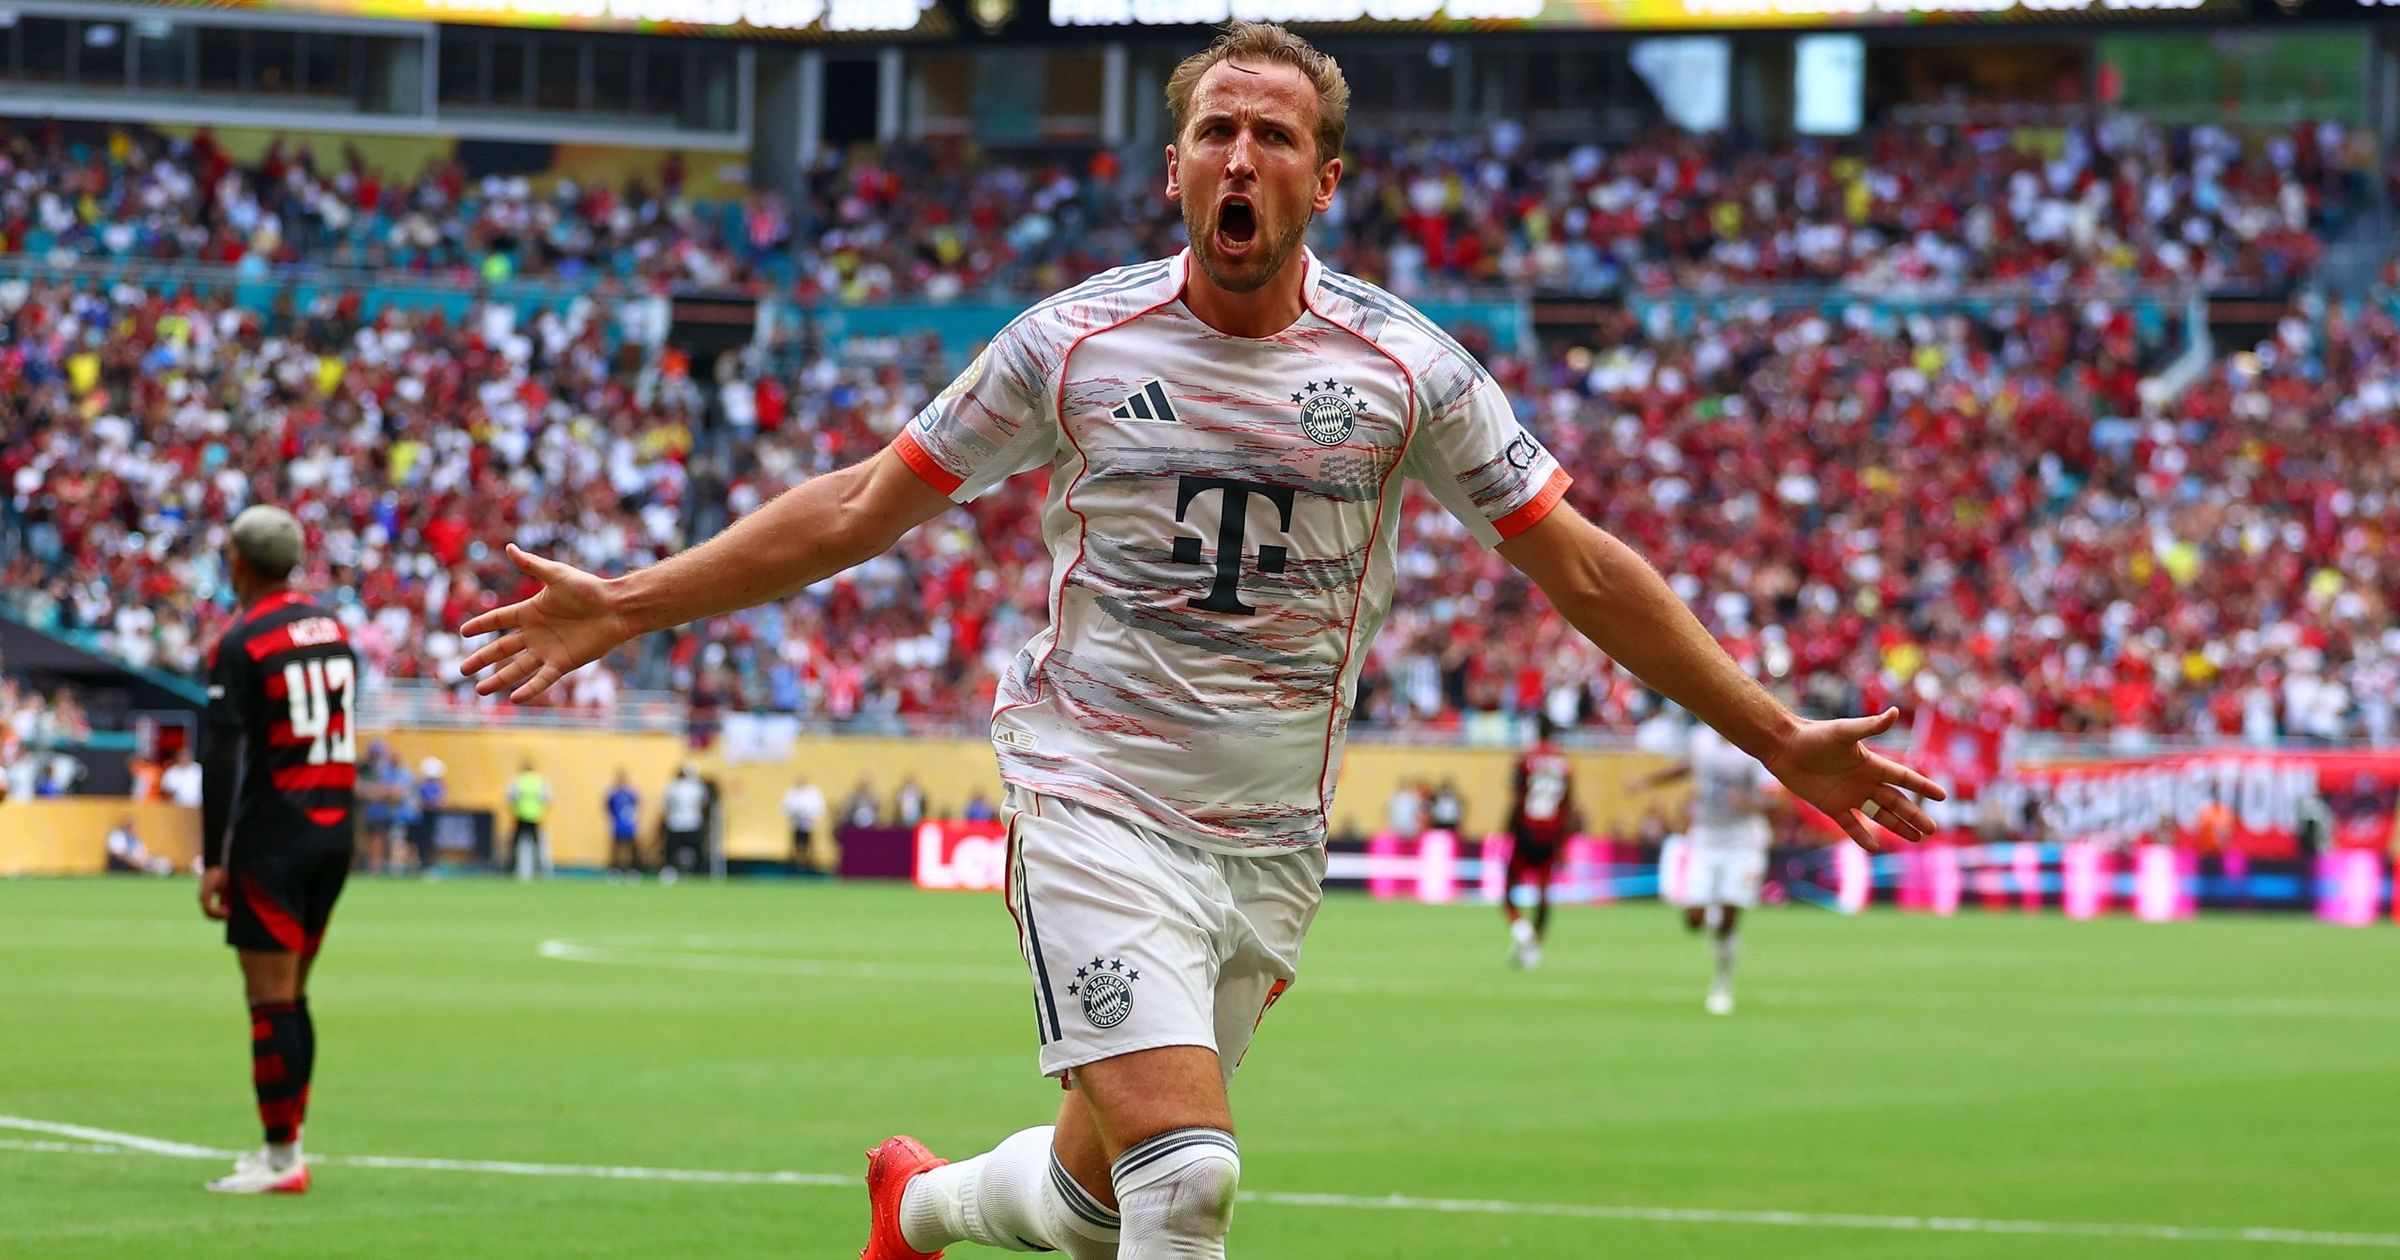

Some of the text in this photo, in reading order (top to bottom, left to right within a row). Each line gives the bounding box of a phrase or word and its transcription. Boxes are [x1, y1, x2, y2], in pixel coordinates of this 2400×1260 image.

[1306, 397, 1351, 418] FC BAYERN
[284, 659, 356, 765] 43
[1085, 976, 1126, 1001] FC BAYERN
